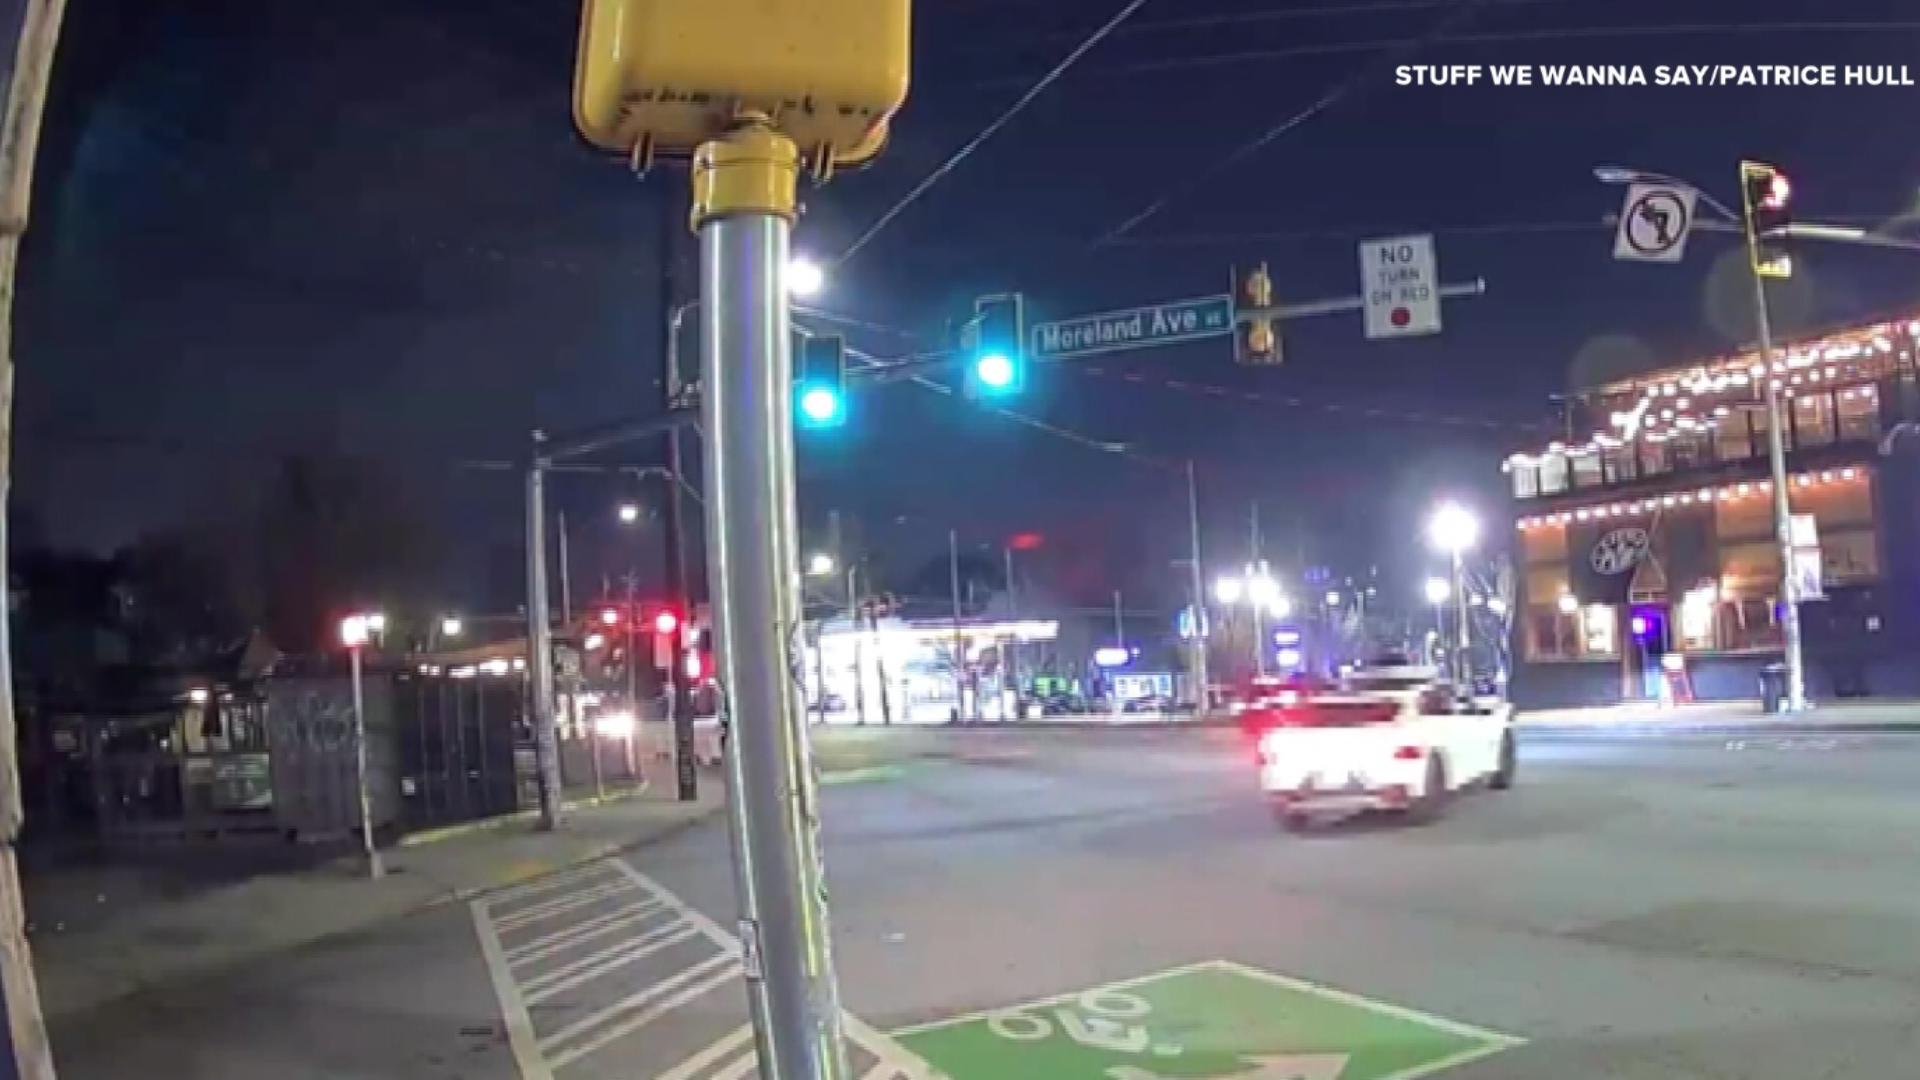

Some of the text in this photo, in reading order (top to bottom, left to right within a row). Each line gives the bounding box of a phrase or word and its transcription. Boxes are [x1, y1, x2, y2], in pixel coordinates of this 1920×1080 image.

[1381, 246, 1414, 264] NO
[1043, 312, 1141, 350] Moreland
[1151, 308, 1197, 335] Ave
